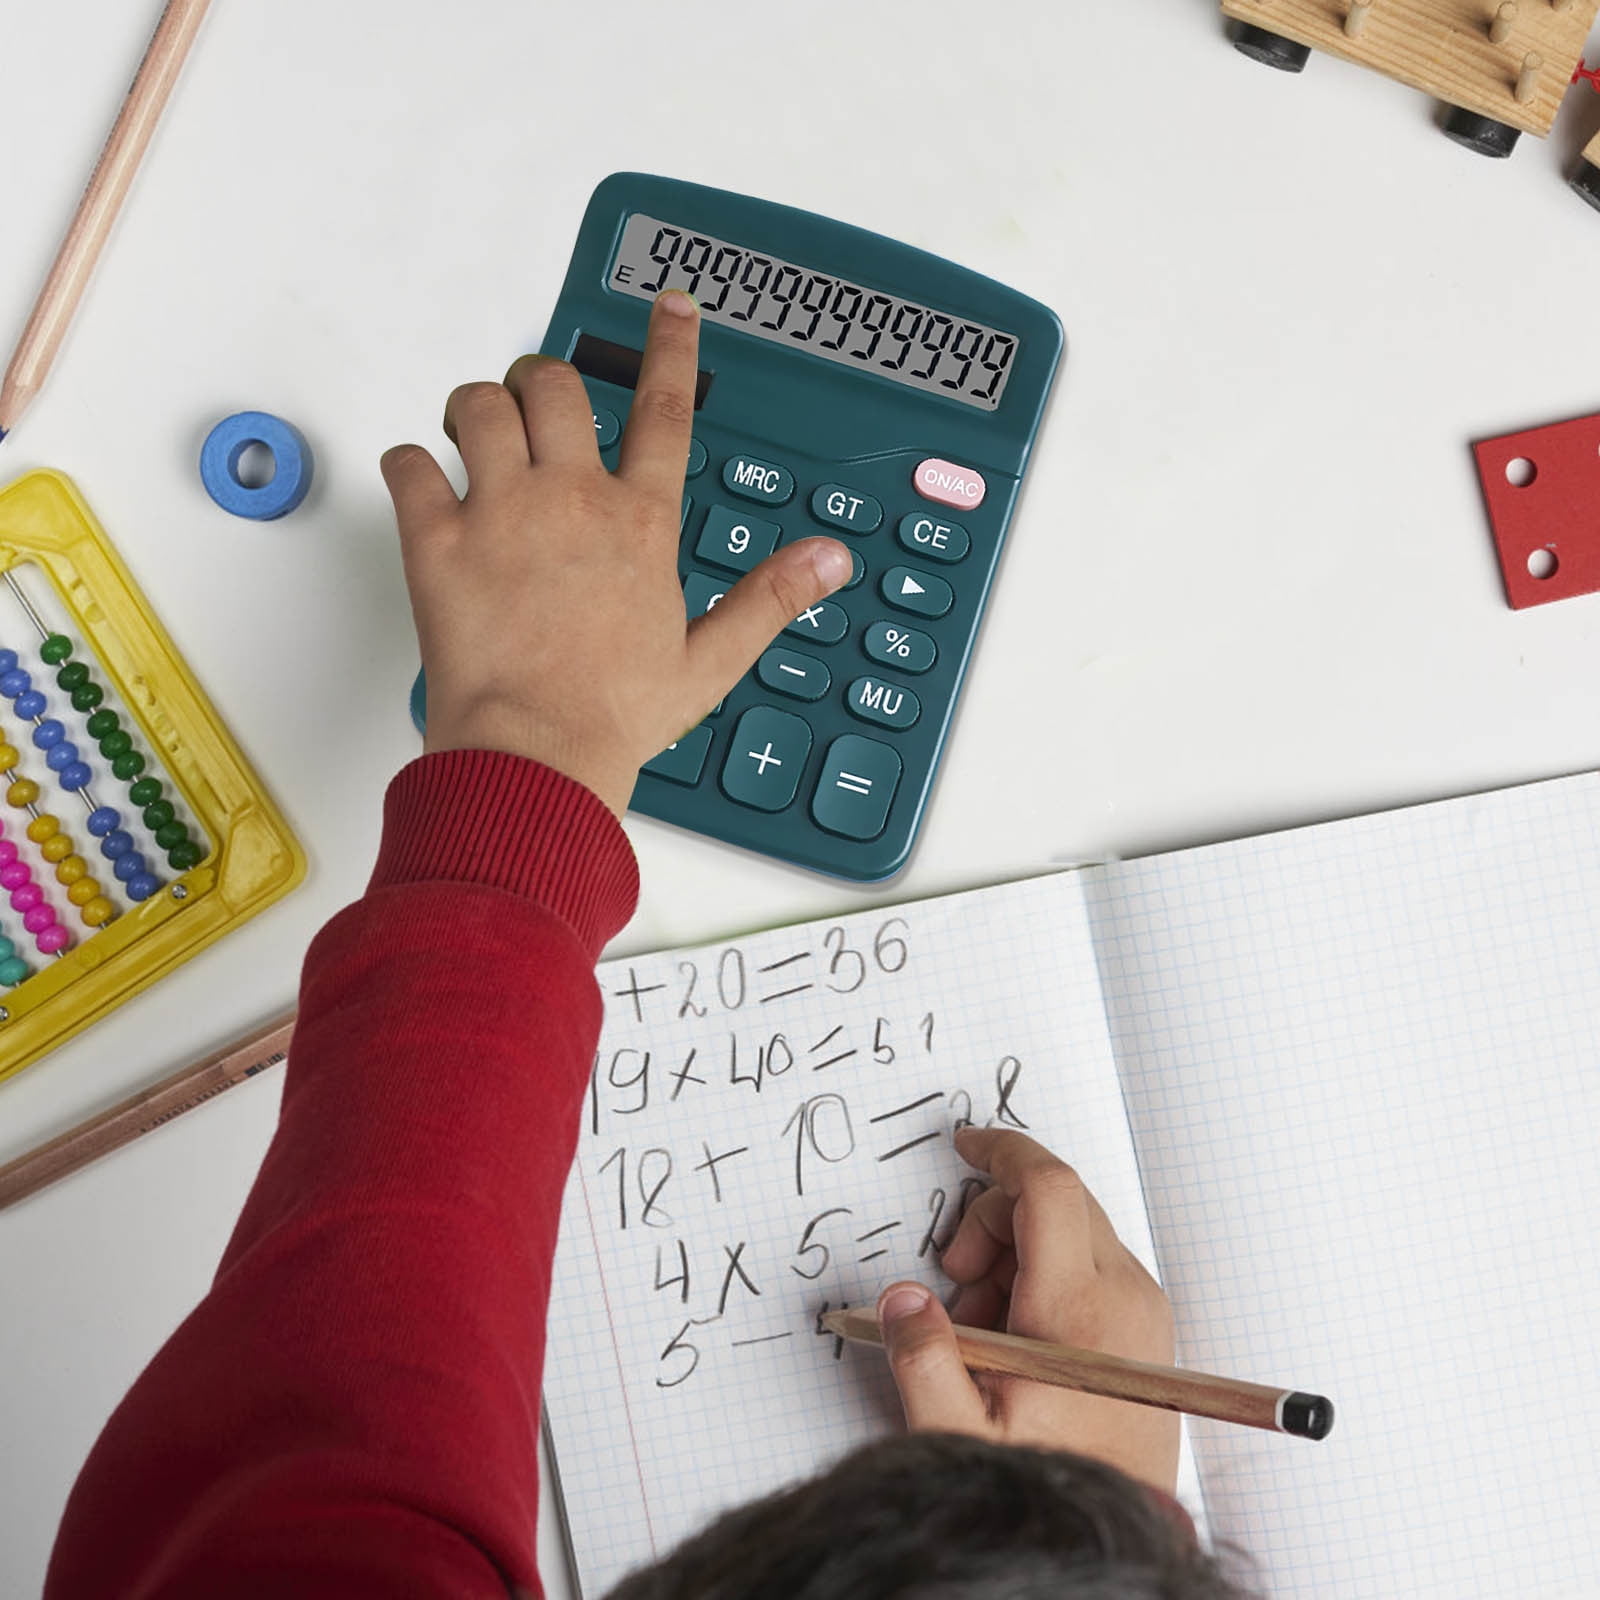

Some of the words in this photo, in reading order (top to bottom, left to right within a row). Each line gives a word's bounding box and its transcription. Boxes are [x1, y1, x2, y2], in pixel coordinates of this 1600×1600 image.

[615, 264, 636, 284] E
[733, 460, 781, 493] MRC
[923, 467, 979, 498] ON/AC
[826, 491, 865, 521] GT
[726, 525, 751, 554] 9
[913, 519, 951, 549] CE
[885, 628, 911, 658] %
[859, 681, 904, 716] MU
